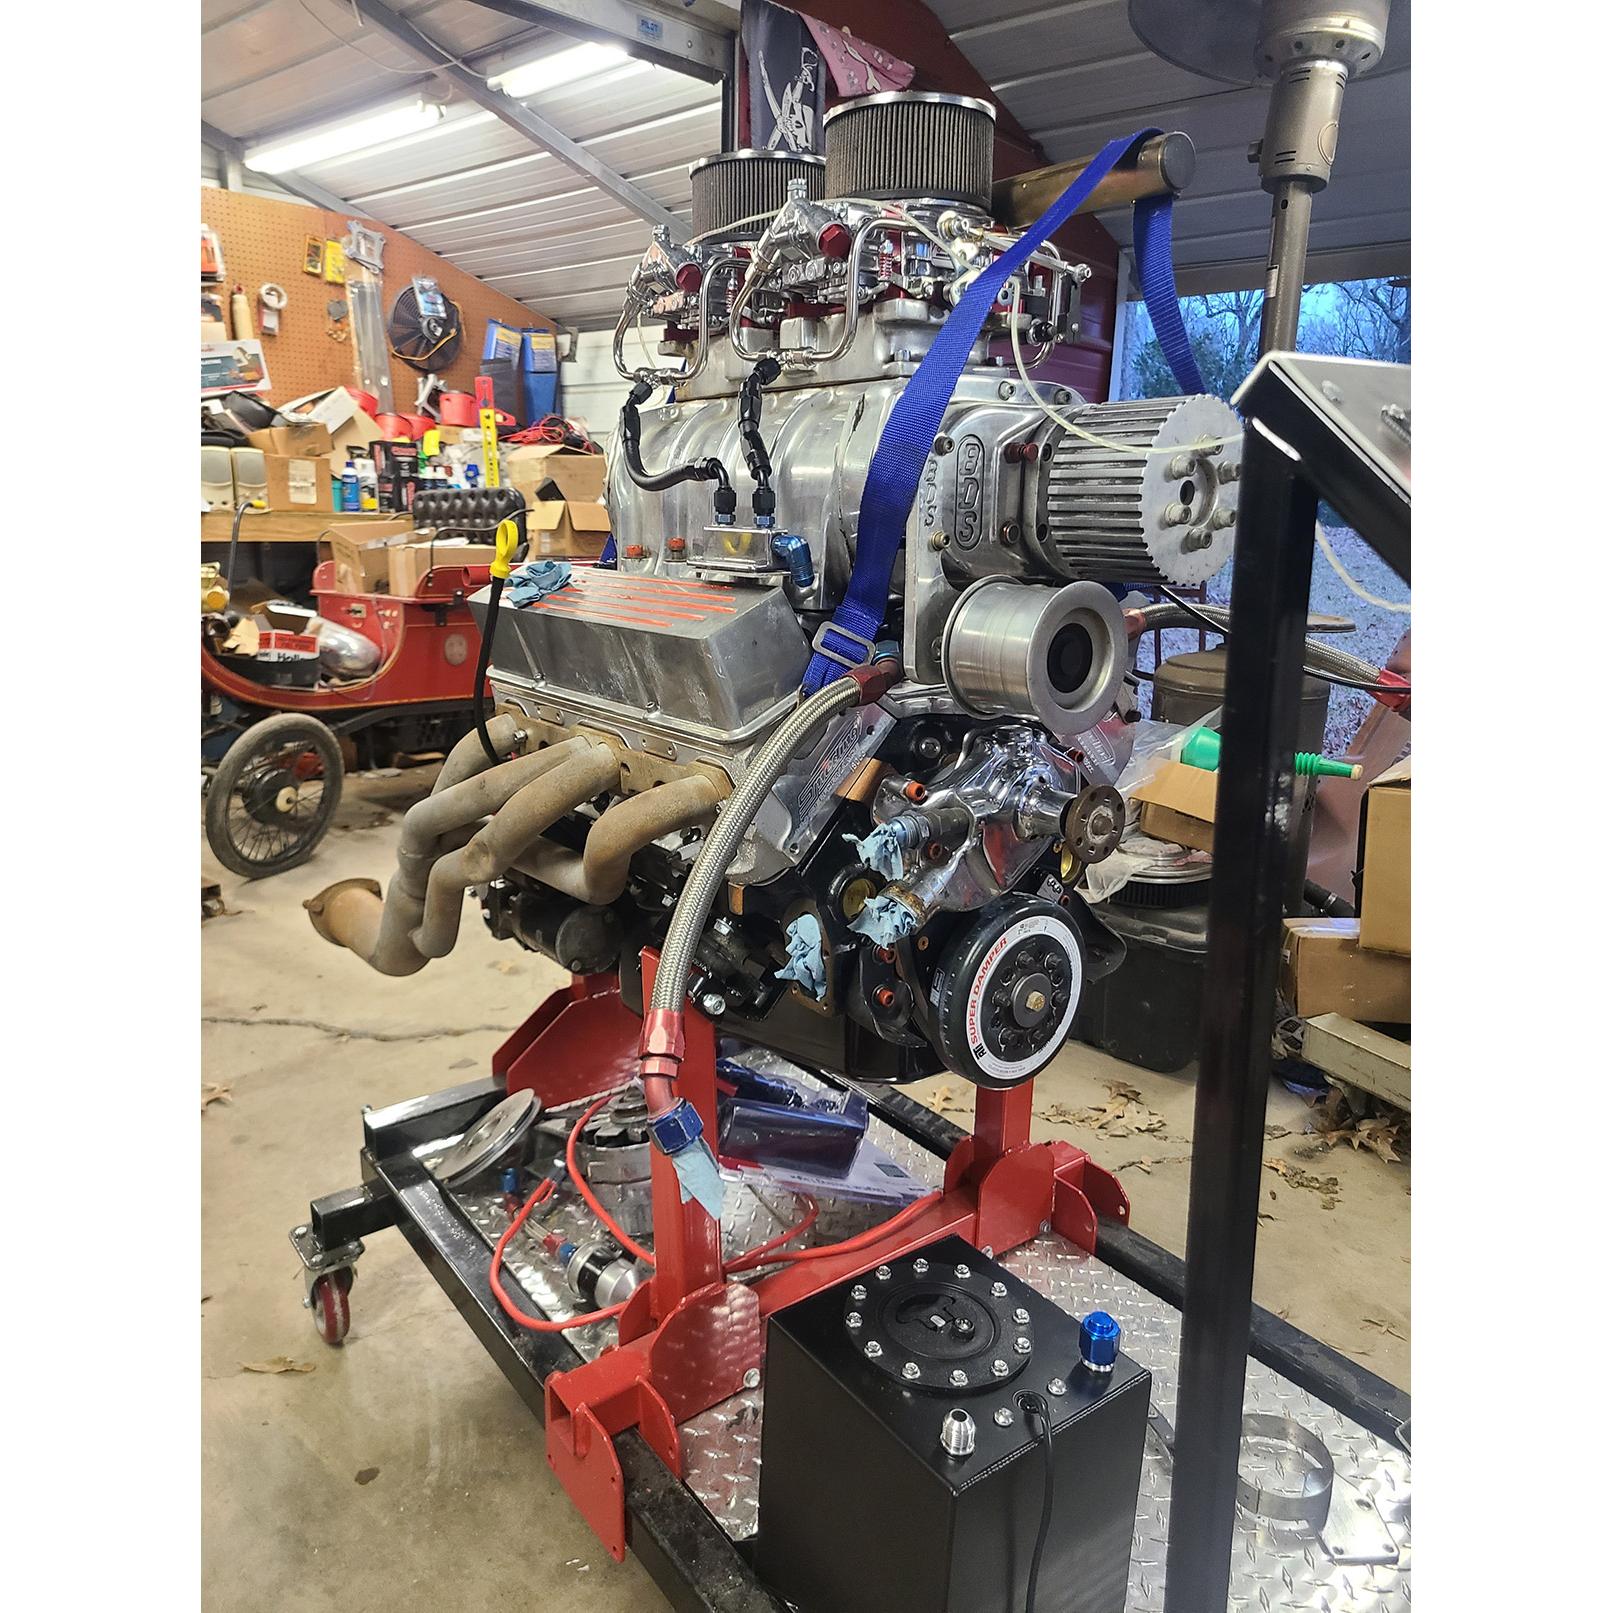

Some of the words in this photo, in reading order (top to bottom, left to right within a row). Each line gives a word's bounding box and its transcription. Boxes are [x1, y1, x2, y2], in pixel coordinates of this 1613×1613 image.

[958, 442, 981, 543] BDS
[968, 1000, 978, 1045] SUPER
[974, 938, 1007, 996] DAMPER
